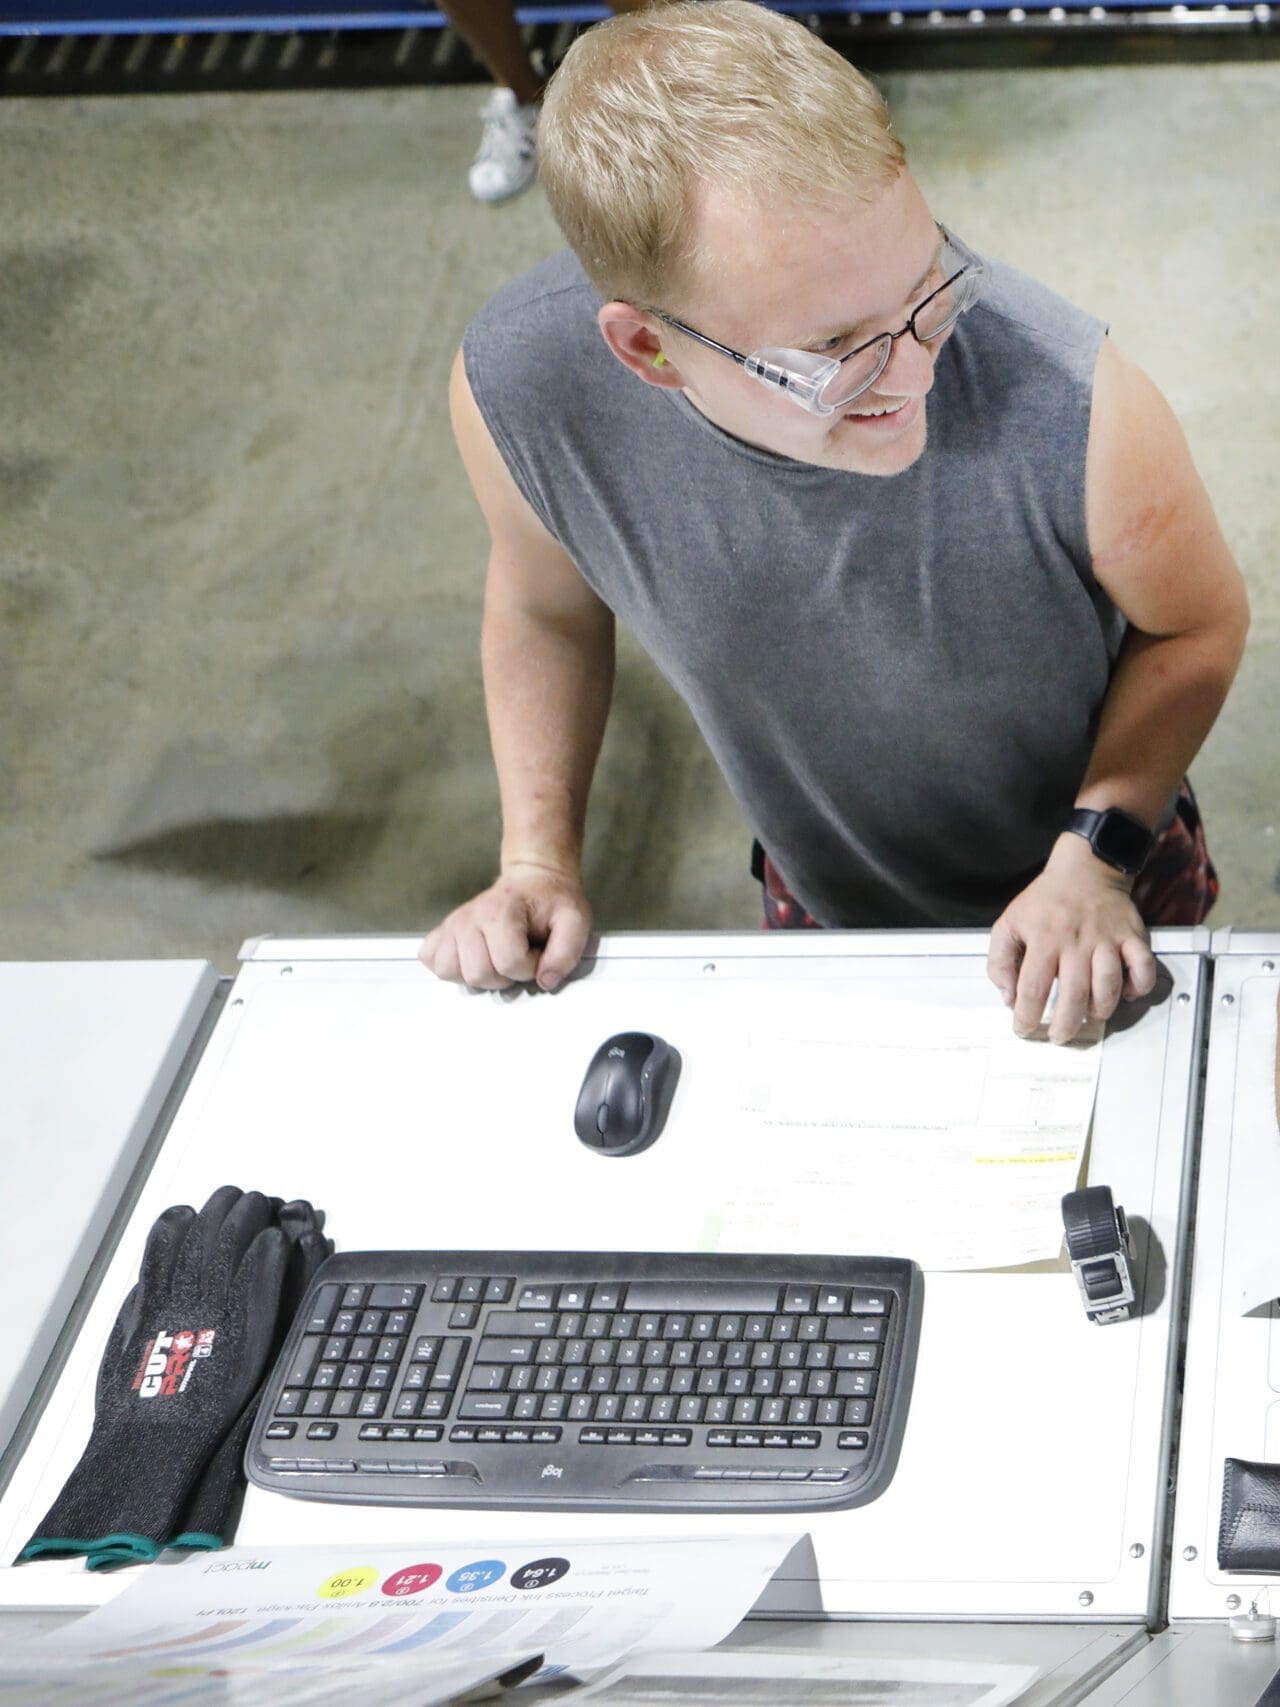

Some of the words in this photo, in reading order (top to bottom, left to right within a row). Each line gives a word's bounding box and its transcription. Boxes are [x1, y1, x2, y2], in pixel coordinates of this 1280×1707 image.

[140, 1330, 174, 1398] CUT
[541, 1464, 564, 1478] logi
[458, 1570, 492, 1581] 1.35
[523, 1568, 557, 1579] 1.64
[330, 1578, 365, 1588] 1.00
[397, 1574, 429, 1586] 1.21
[520, 1593, 542, 1601] Ink
[546, 1590, 603, 1600] Process
[608, 1587, 649, 1597] Target
[426, 1598, 448, 1606] for
[452, 1594, 516, 1606] Densities
